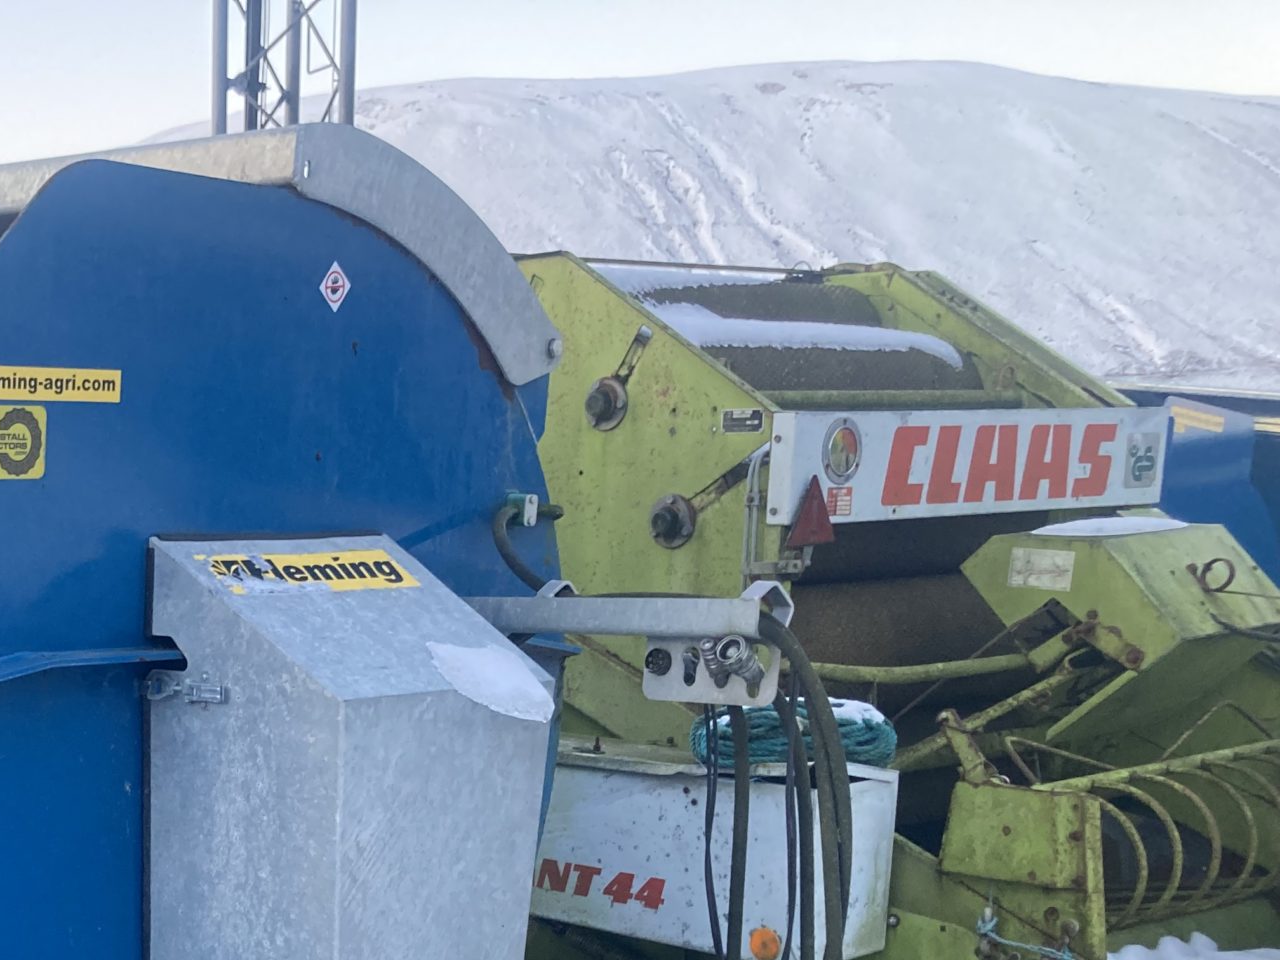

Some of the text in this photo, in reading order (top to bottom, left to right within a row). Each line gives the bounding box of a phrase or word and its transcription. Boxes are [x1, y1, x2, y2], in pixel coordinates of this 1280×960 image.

[881, 424, 1118, 507] CLAAS
[533, 858, 666, 910] NT 44
